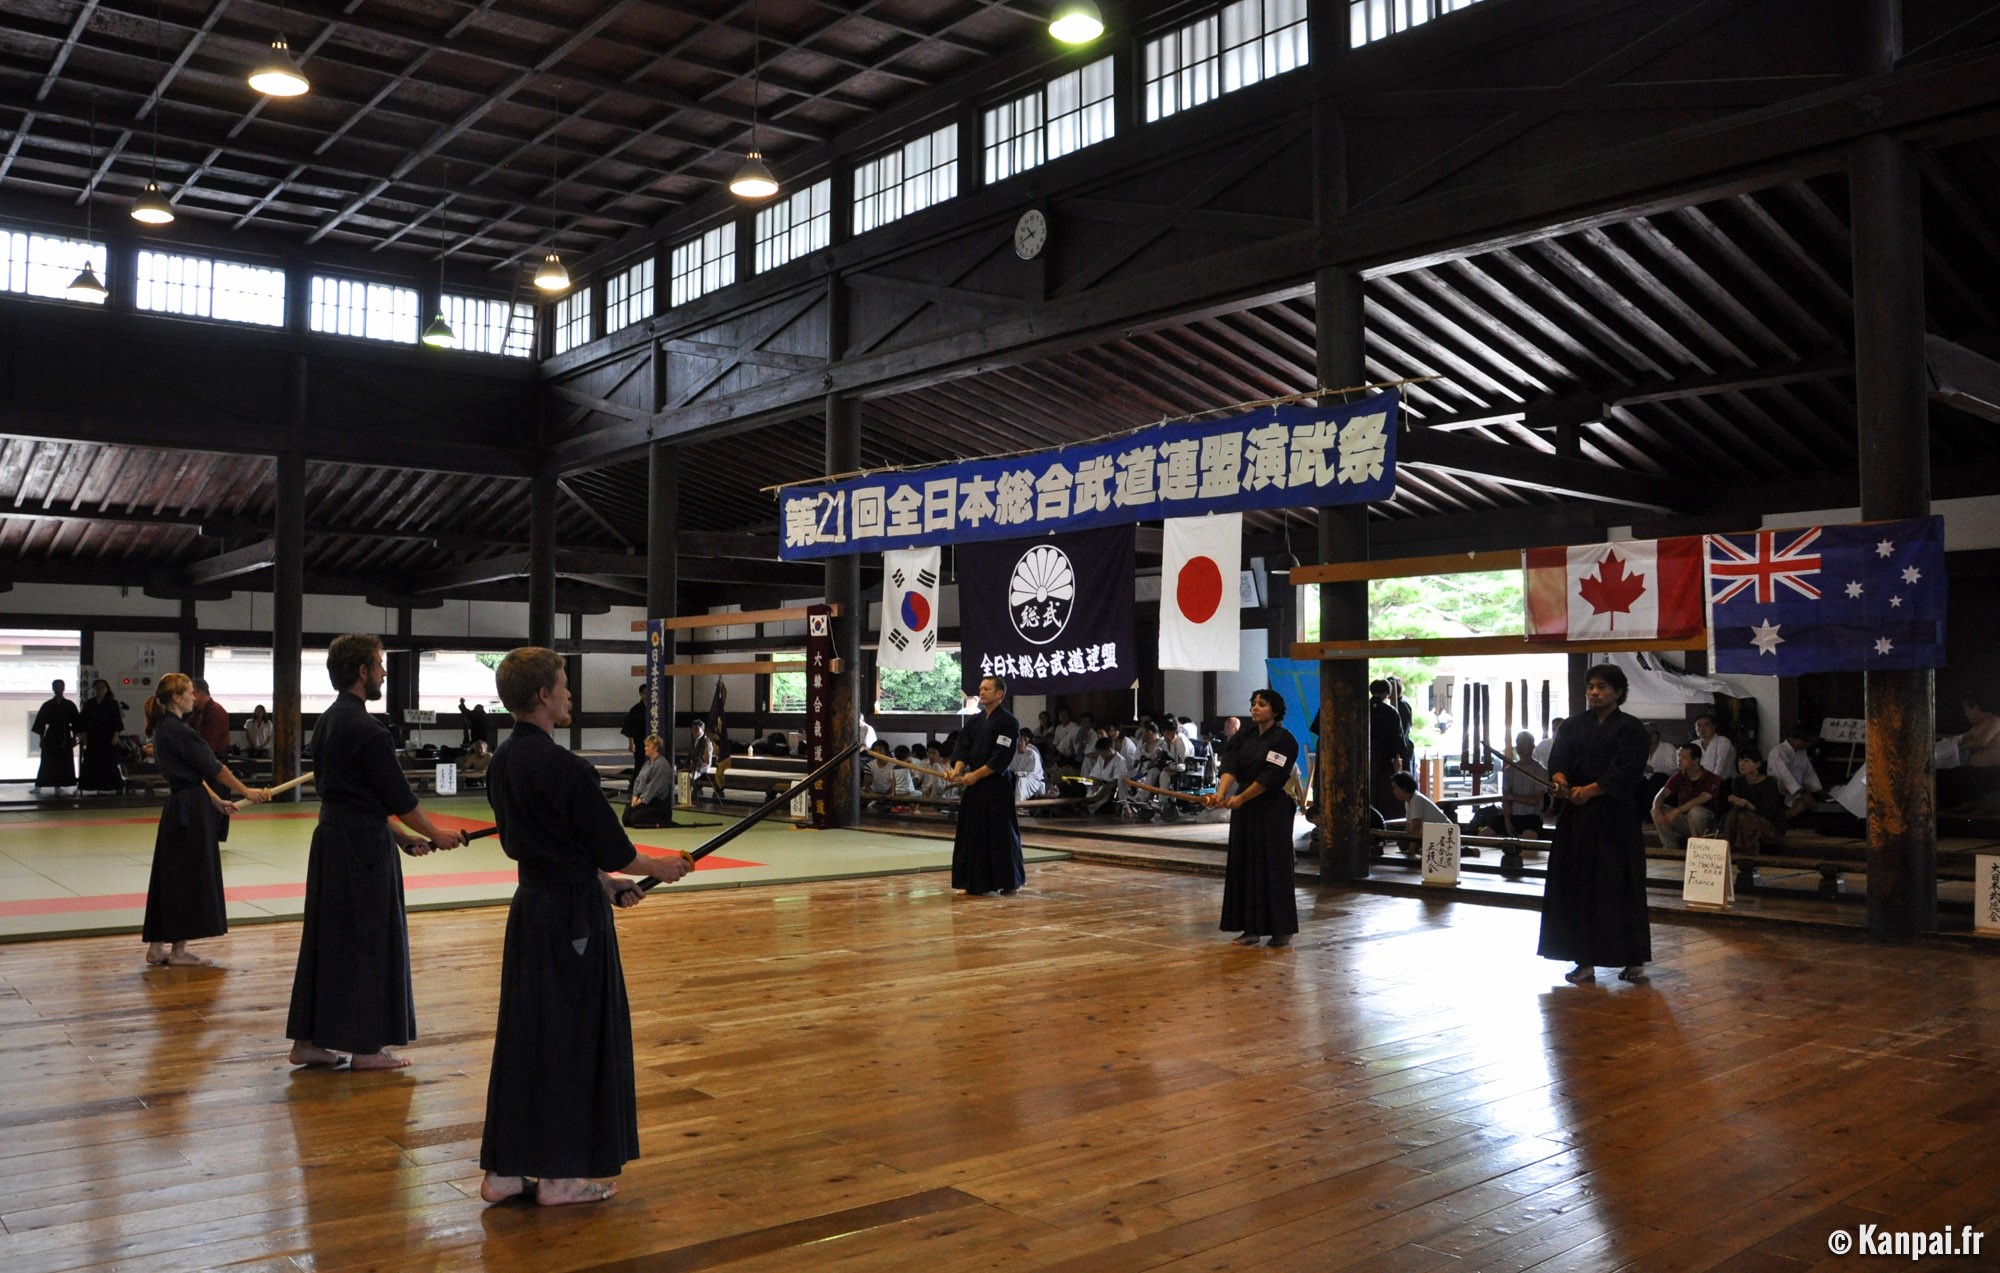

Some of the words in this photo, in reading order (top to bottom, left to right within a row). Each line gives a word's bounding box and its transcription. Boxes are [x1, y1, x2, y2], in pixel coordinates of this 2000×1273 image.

[784, 411, 1388, 548] 第21回全日本総合武道連盟演武祭
[1020, 601, 1062, 629] 総武
[980, 642, 1119, 679] 全日本総合武道連盟
